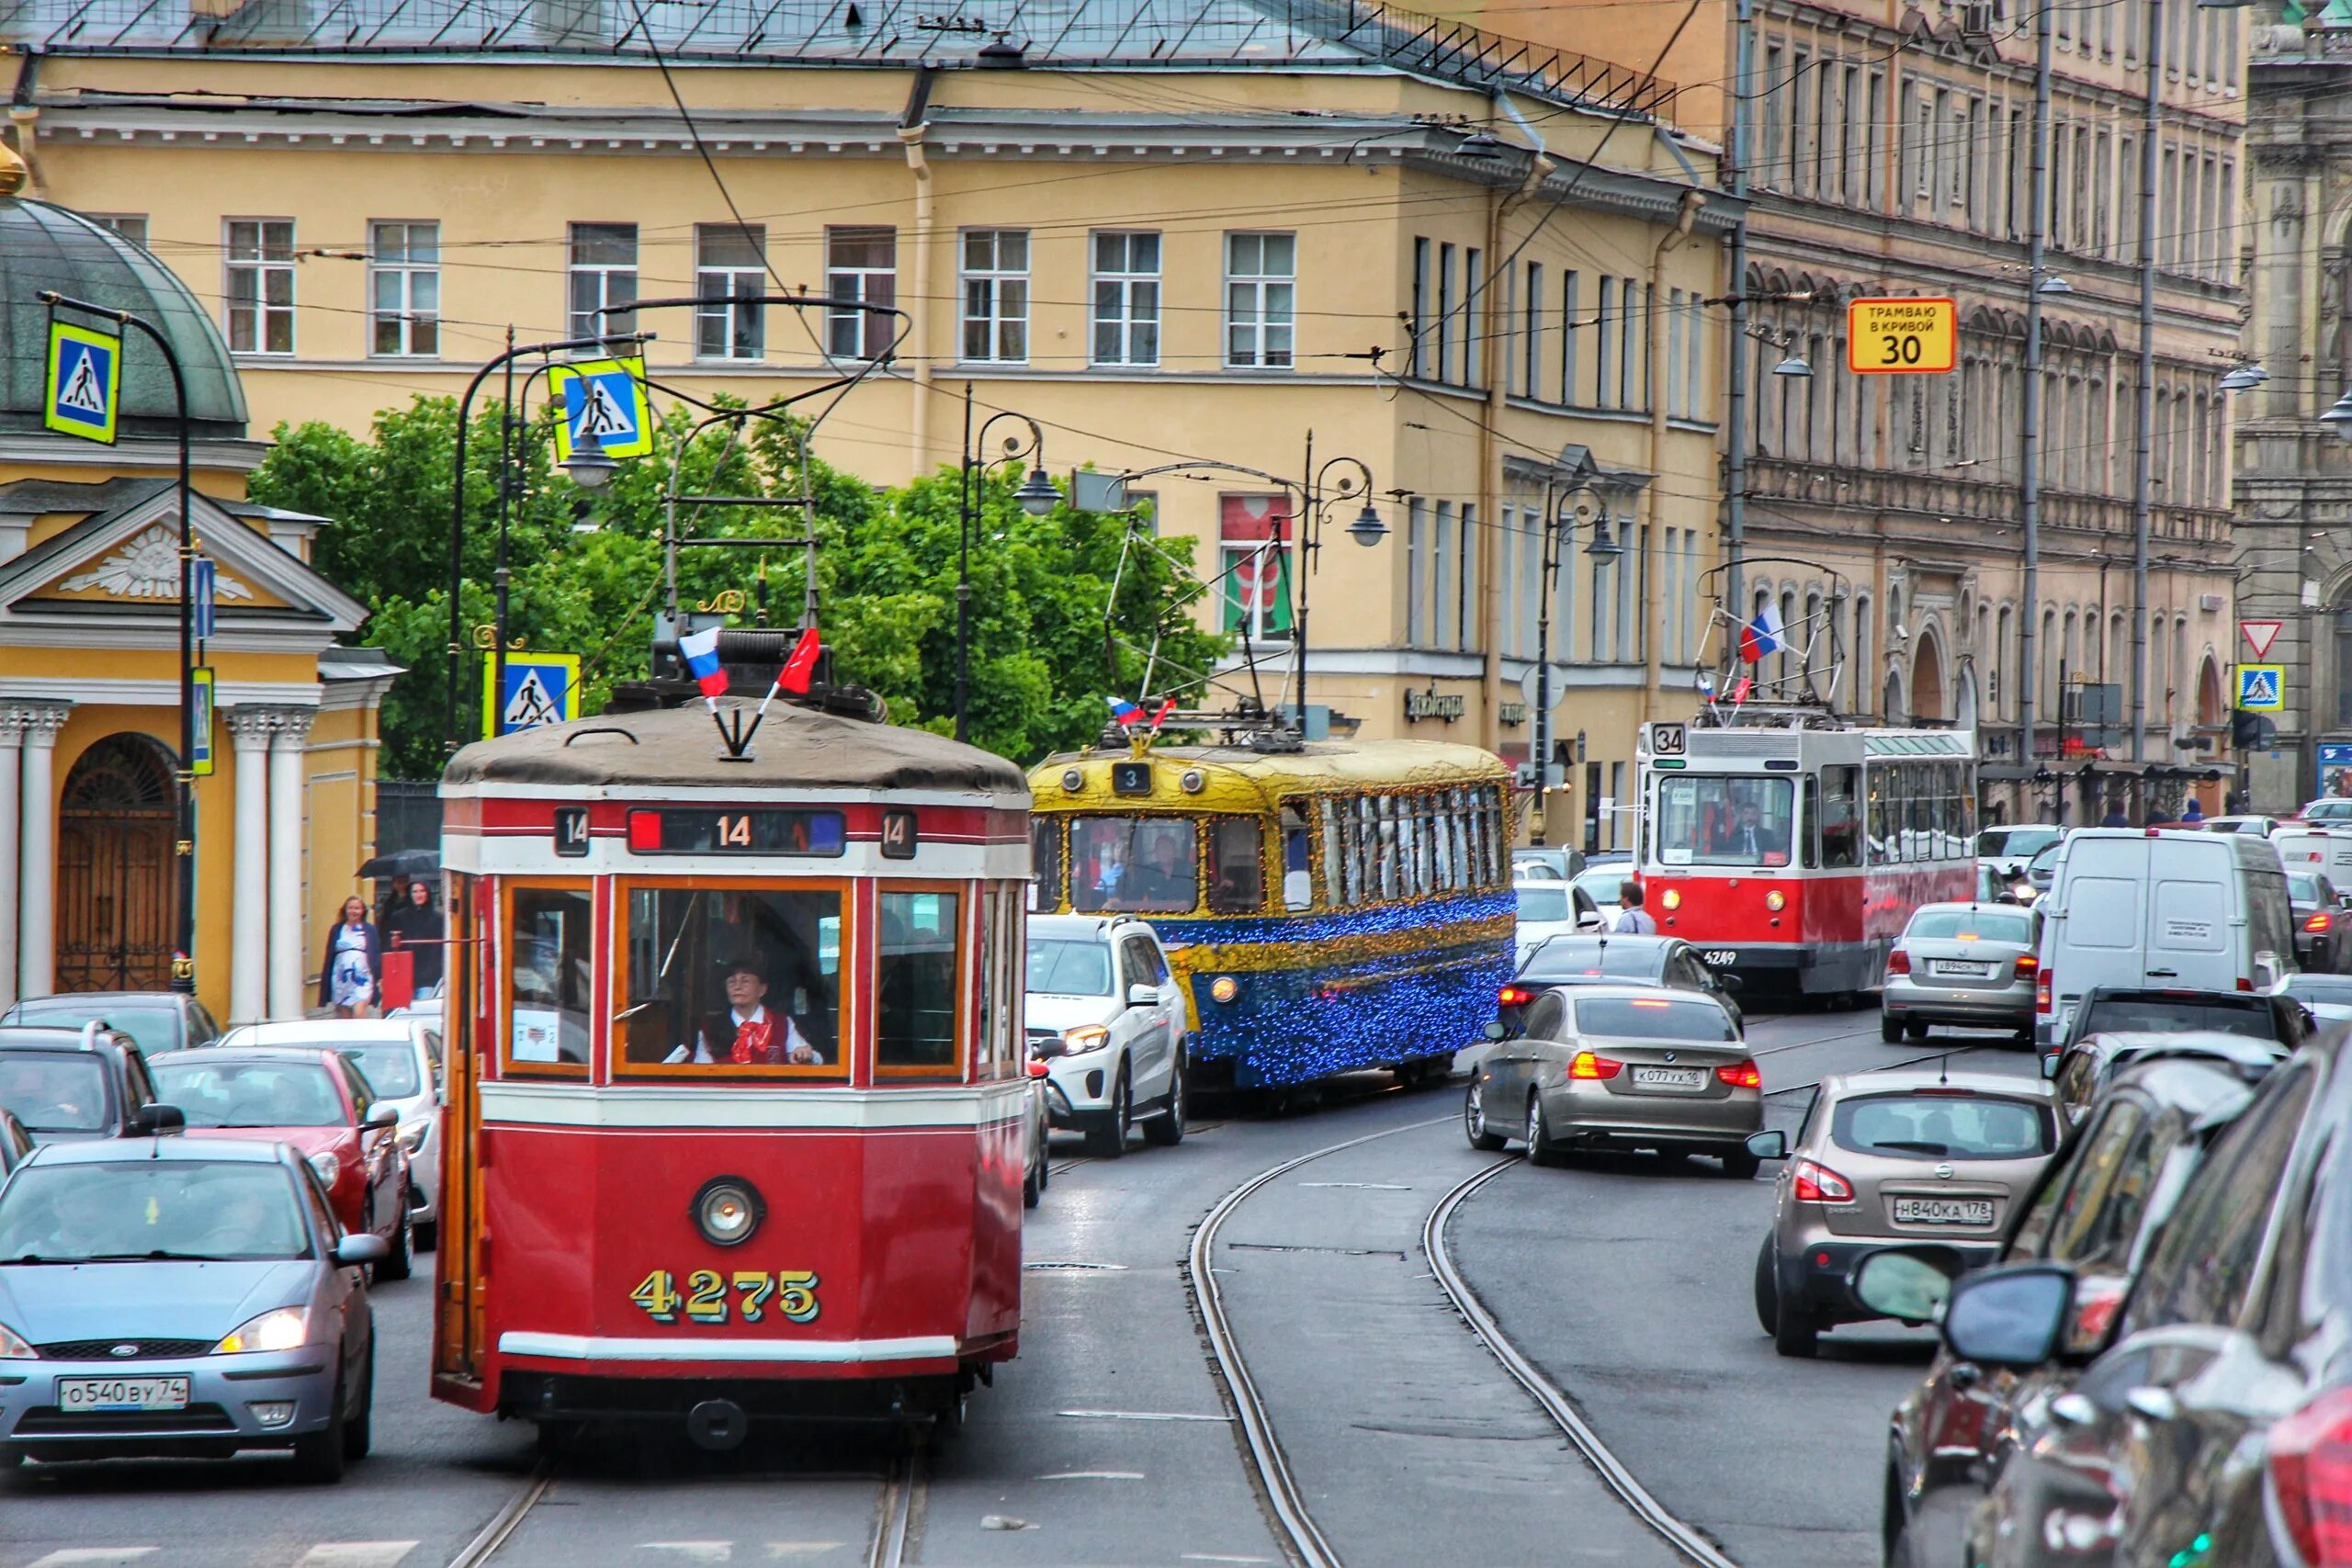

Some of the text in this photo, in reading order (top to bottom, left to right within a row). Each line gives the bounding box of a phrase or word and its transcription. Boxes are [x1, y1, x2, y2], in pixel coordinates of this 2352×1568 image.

[1869, 307, 1936, 318] ТРАМВАЮ
[1871, 319, 1934, 332] В КРИВОЙ
[1882, 335, 1921, 364] 30
[1657, 729, 1681, 751] 34
[1125, 770, 1136, 787] 3
[567, 814, 588, 843] 14
[717, 815, 751, 846] 14
[883, 815, 905, 845] 14
[629, 1269, 820, 1325] 4275
[159, 1380, 180, 1395] 74
